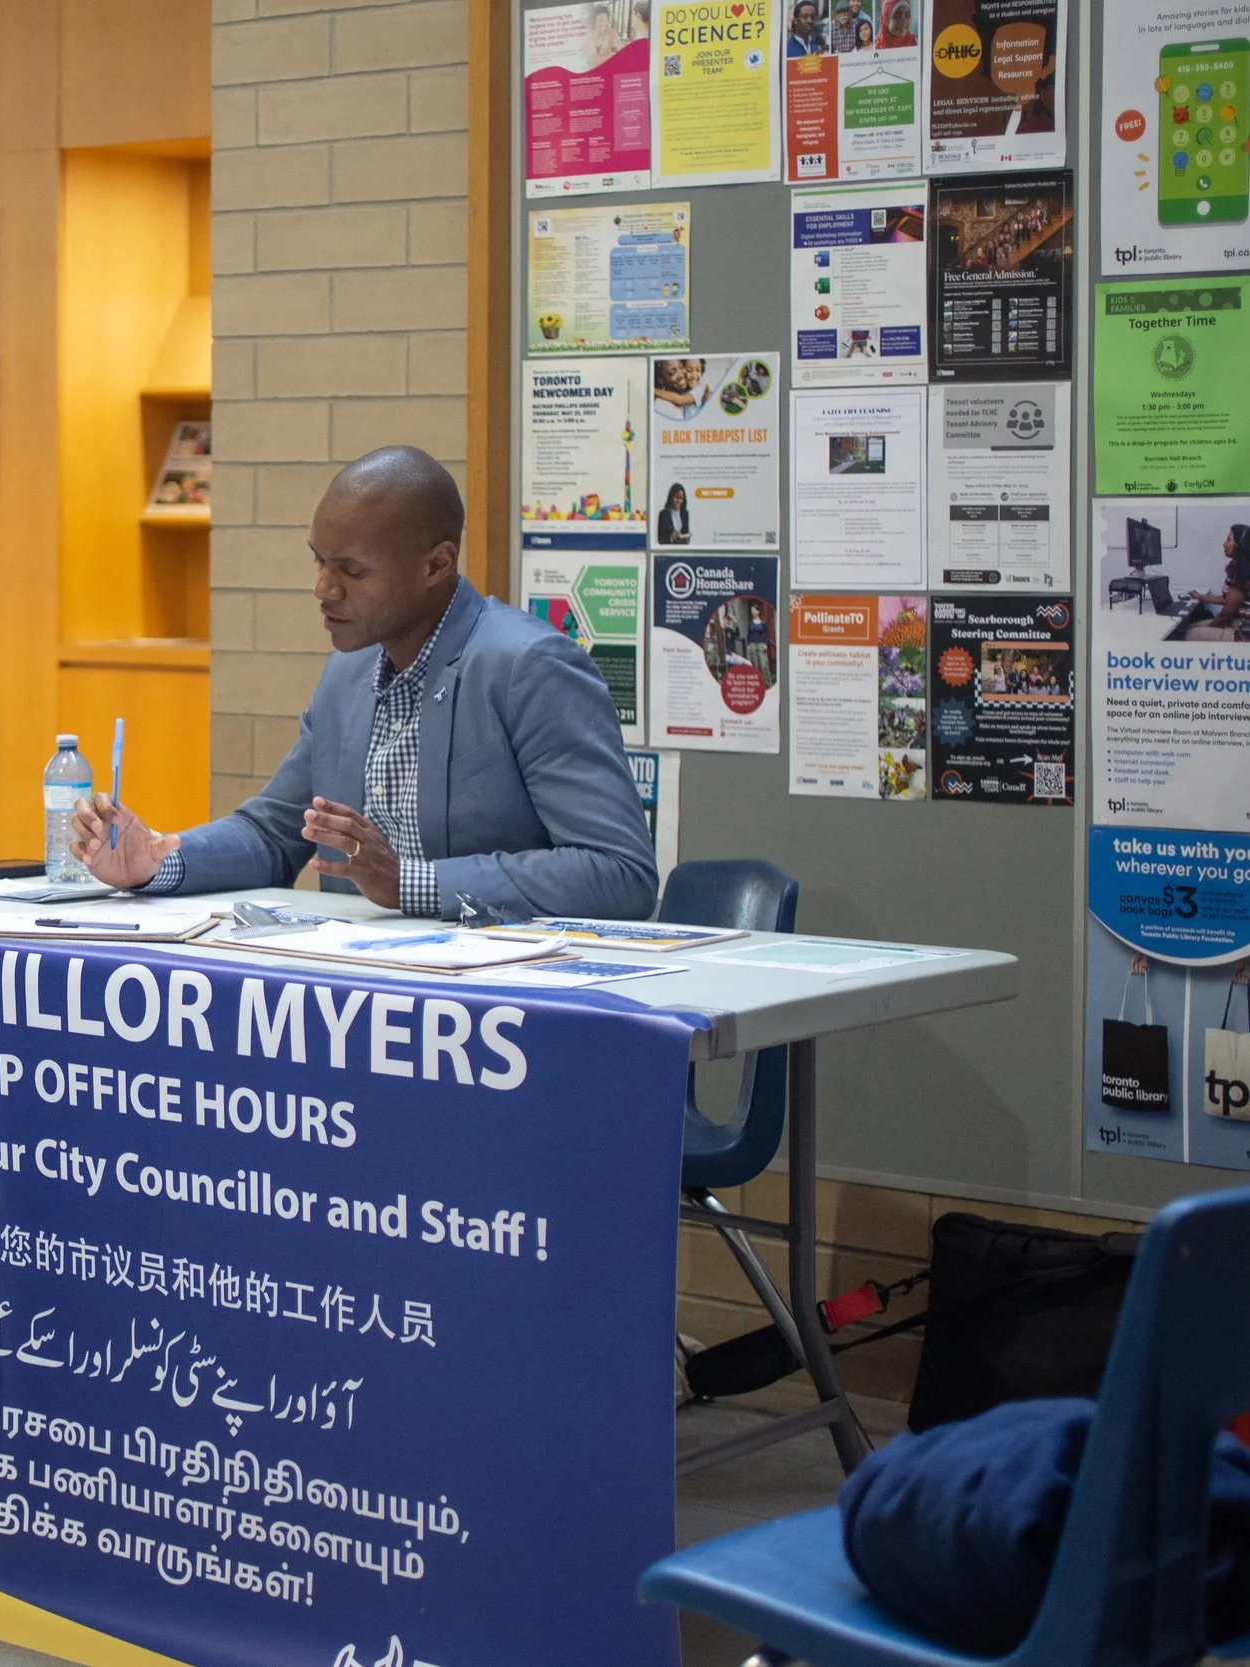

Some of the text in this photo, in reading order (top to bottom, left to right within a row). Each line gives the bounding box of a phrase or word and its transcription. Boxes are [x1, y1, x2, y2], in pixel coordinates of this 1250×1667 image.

[666, 5, 719, 24] DO YOU
[1157, 9, 1219, 22] Amazing stories
[665, 21, 765, 46] SCIENCE?
[996, 39, 1039, 49] Information
[695, 49, 731, 58] JOIN OUR
[994, 52, 1043, 64] Legal Support
[692, 58, 734, 67] PRESENTER
[998, 70, 1033, 79] Resources
[1119, 120, 1142, 131] FREE!
[806, 214, 835, 222] ESSENTIAL
[818, 221, 854, 229] EMPLOYMENT
[1115, 246, 1137, 265] tpl
[944, 272, 959, 282] Free
[961, 271, 992, 281] General
[1129, 316, 1216, 331] Together Time
[533, 376, 581, 386] TORONTO
[533, 387, 614, 398] NEWCOMER DAY
[662, 429, 768, 444] BLACK THERAPIST LIST
[696, 566, 734, 578] Canada
[594, 579, 637, 587] TORONTO
[696, 579, 754, 591] HomeShare
[583, 588, 637, 596] COMMUNITY
[600, 608, 635, 616] SERVICE
[804, 612, 864, 624] PollinateTO
[968, 614, 1034, 626] Scarborough
[823, 625, 844, 634] Grants
[952, 629, 1051, 641] Steering Committee
[1107, 651, 1193, 669] book our
[1107, 673, 1199, 692] interview
[1108, 797, 1125, 814] tpl
[1113, 837, 1219, 859] take us with
[1116, 857, 1228, 881] wherever you
[1163, 884, 1198, 919] $3
[237, 977, 528, 1090] MYERS
[1102, 1073, 1139, 1088] toronto
[1102, 1087, 1169, 1103] public library
[35, 1059, 181, 1123] OFFICE
[195, 1080, 357, 1148] HOURS
[35, 1138, 106, 1196] City
[116, 1152, 317, 1222] Councillor
[327, 1194, 407, 1238] and
[421, 1201, 525, 1257] Staff
[124, 1426, 469, 1544] பிரதிநிதியையும்,
[28, 1458, 424, 1585] பணியாளர்களையும்
[97, 1528, 313, 1606] வாருங்கள்!
